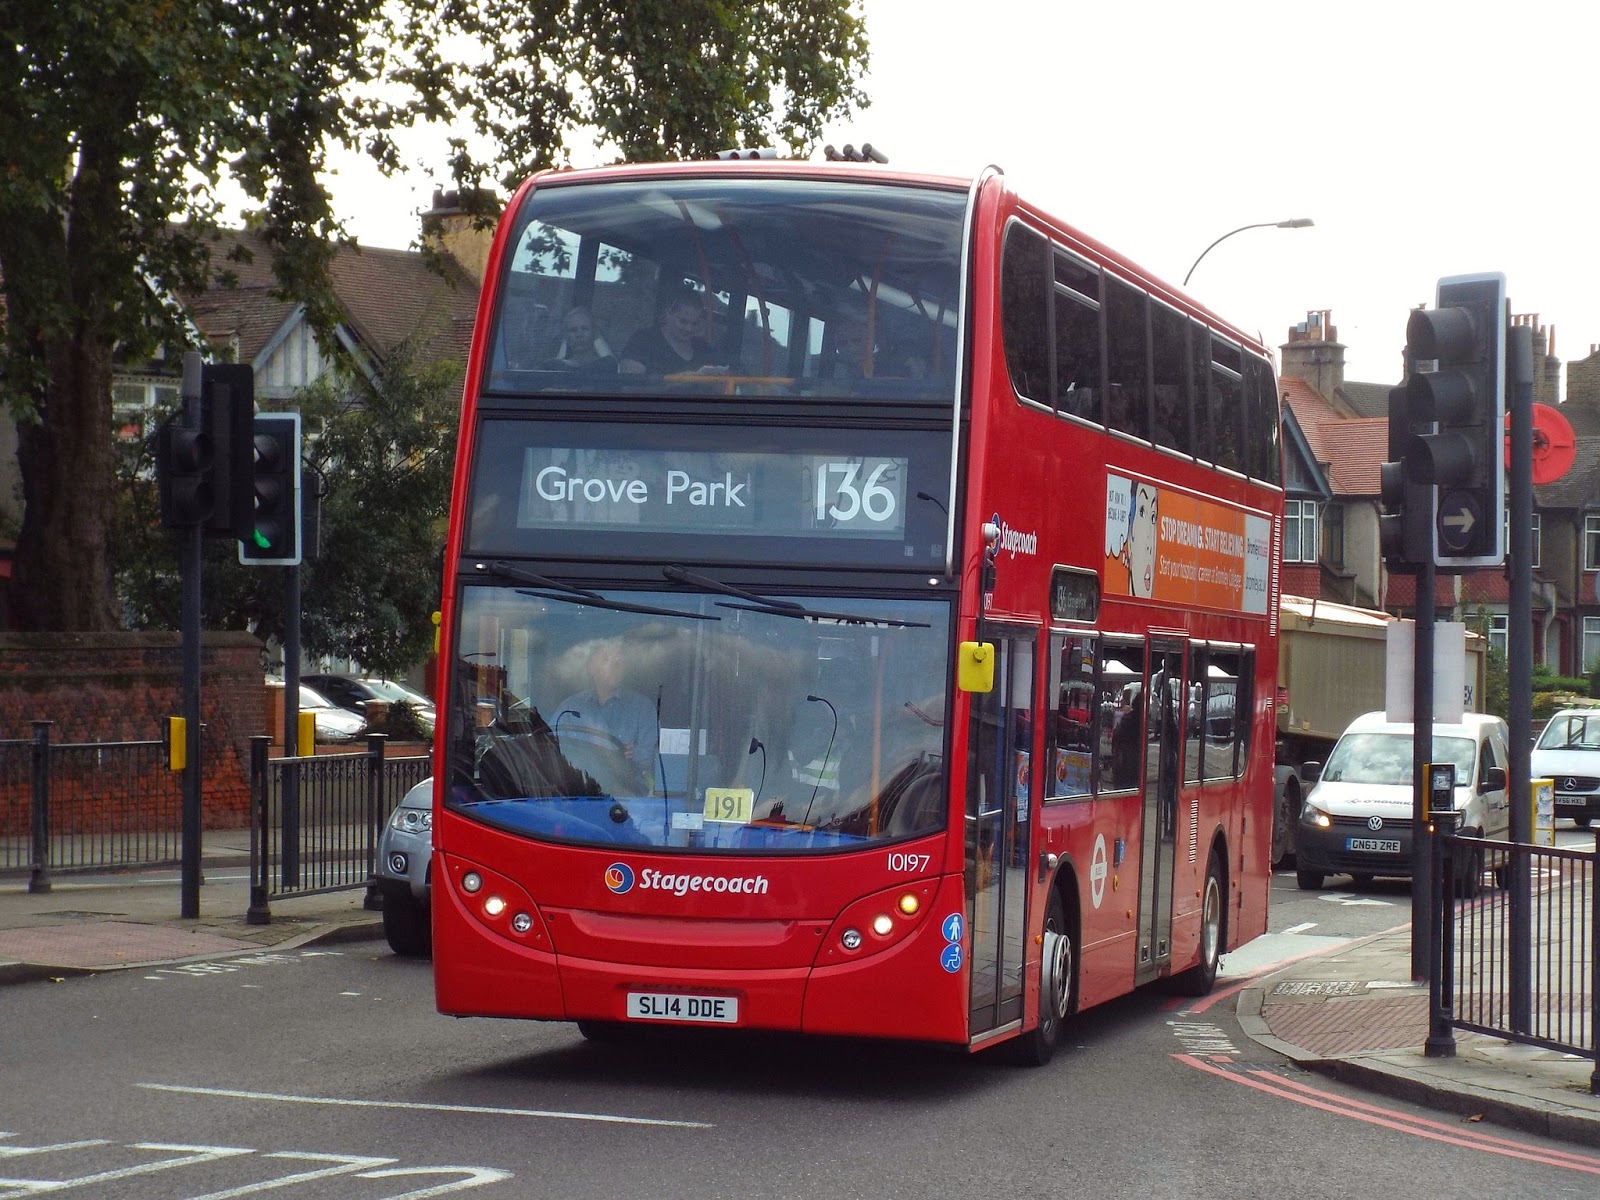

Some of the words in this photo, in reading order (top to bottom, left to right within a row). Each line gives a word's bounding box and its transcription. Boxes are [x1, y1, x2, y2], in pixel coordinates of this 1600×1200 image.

[535, 466, 648, 504] Grove
[666, 470, 747, 507] Park
[816, 462, 896, 522] 136
[1001, 521, 1037, 560] Stagecoach
[1161, 516, 1177, 542] STOP
[1205, 527, 1220, 552] START
[1160, 555, 1170, 575] Start
[714, 796, 742, 819] 191
[1352, 840, 1377, 850] GN63
[1380, 841, 1399, 851] ZRE
[887, 853, 931, 873] 10197
[639, 868, 769, 897] Stagecoach
[639, 996, 681, 1016] SL14
[688, 998, 725, 1018] DDE
